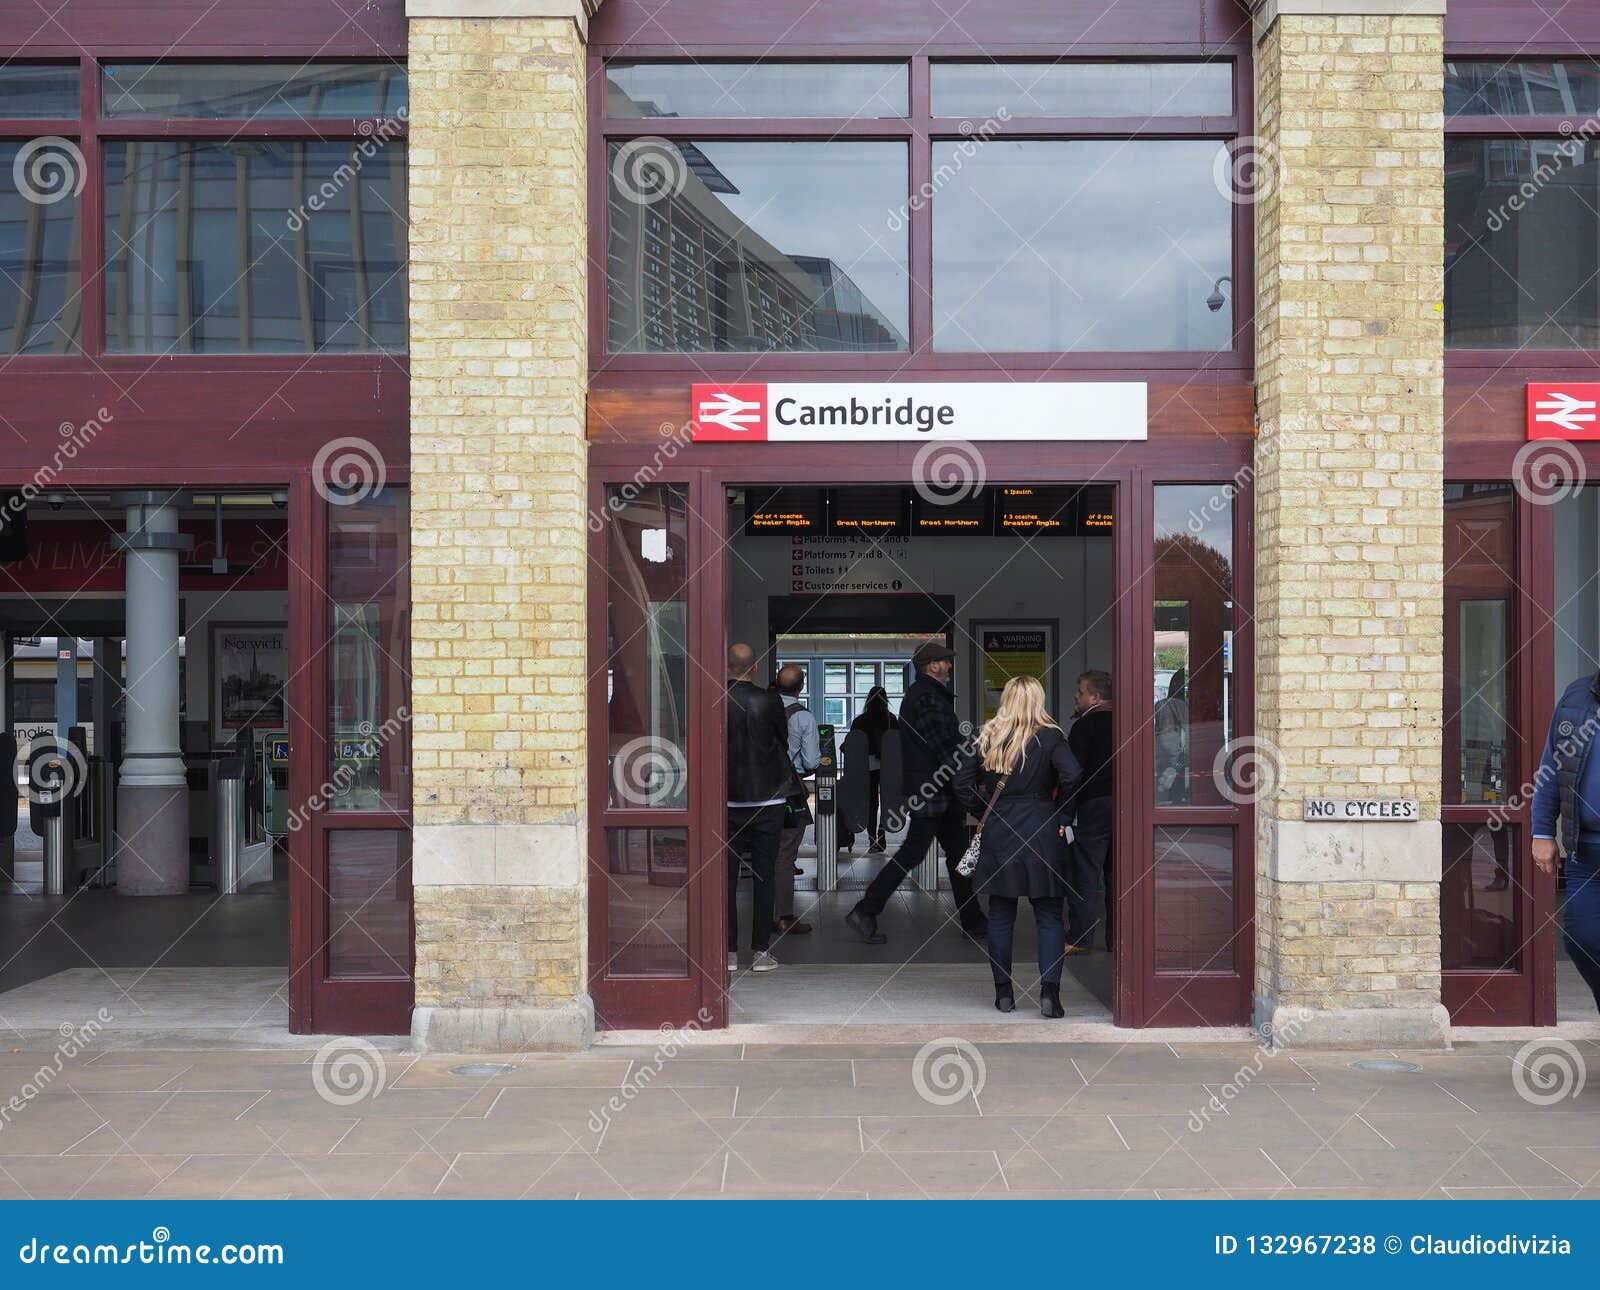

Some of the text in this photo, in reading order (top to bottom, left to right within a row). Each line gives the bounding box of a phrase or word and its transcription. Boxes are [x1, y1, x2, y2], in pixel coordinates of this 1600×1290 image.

[775, 397, 955, 432] Cambridge
[804, 535, 847, 544] Platforms
[884, 535, 901, 544] and
[804, 550, 883, 560] Platforms 7 and 8
[805, 566, 835, 575] Toilets
[804, 581, 888, 590] Customer services
[1002, 635, 1042, 643] WARNING
[14, 726, 54, 742] nglia
[1311, 801, 1412, 816] NO CYCLES
